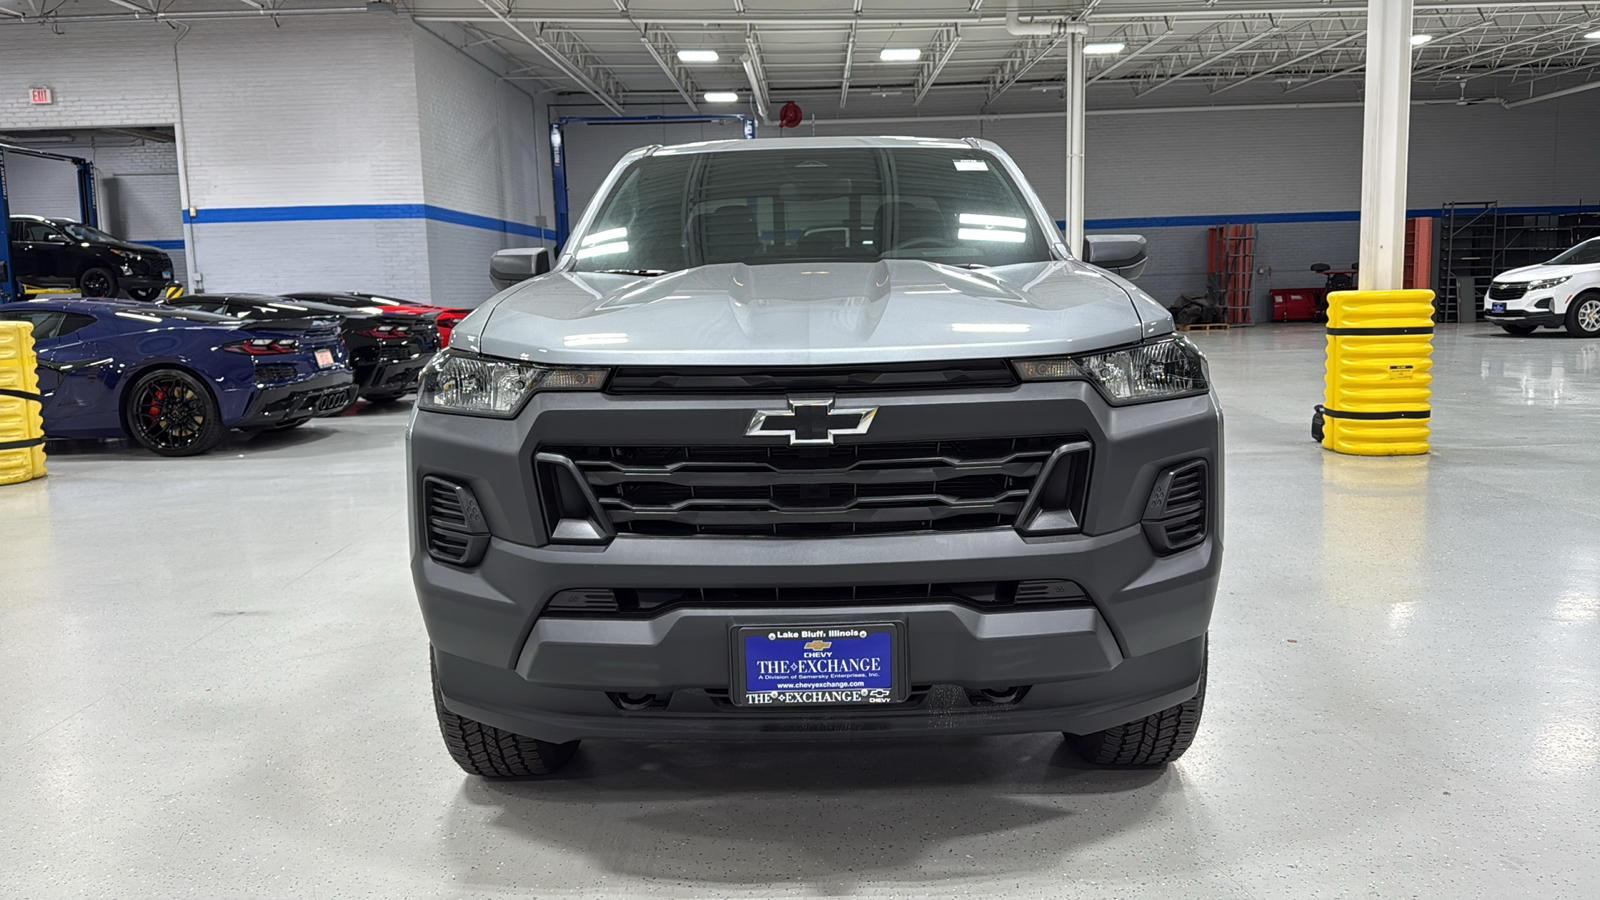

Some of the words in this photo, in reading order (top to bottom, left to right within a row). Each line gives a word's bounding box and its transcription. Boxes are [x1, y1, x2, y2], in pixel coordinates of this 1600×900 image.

[32, 89, 47, 102] EXIT
[801, 630, 826, 639] Bluff,
[828, 629, 859, 638] Illinois
[756, 660, 790, 674] THE
[798, 657, 881, 674] EXCHANGE
[777, 681, 864, 689] www.chevyexchange.com
[745, 692, 773, 704] THE
[785, 690, 862, 703] EXCHANGE
